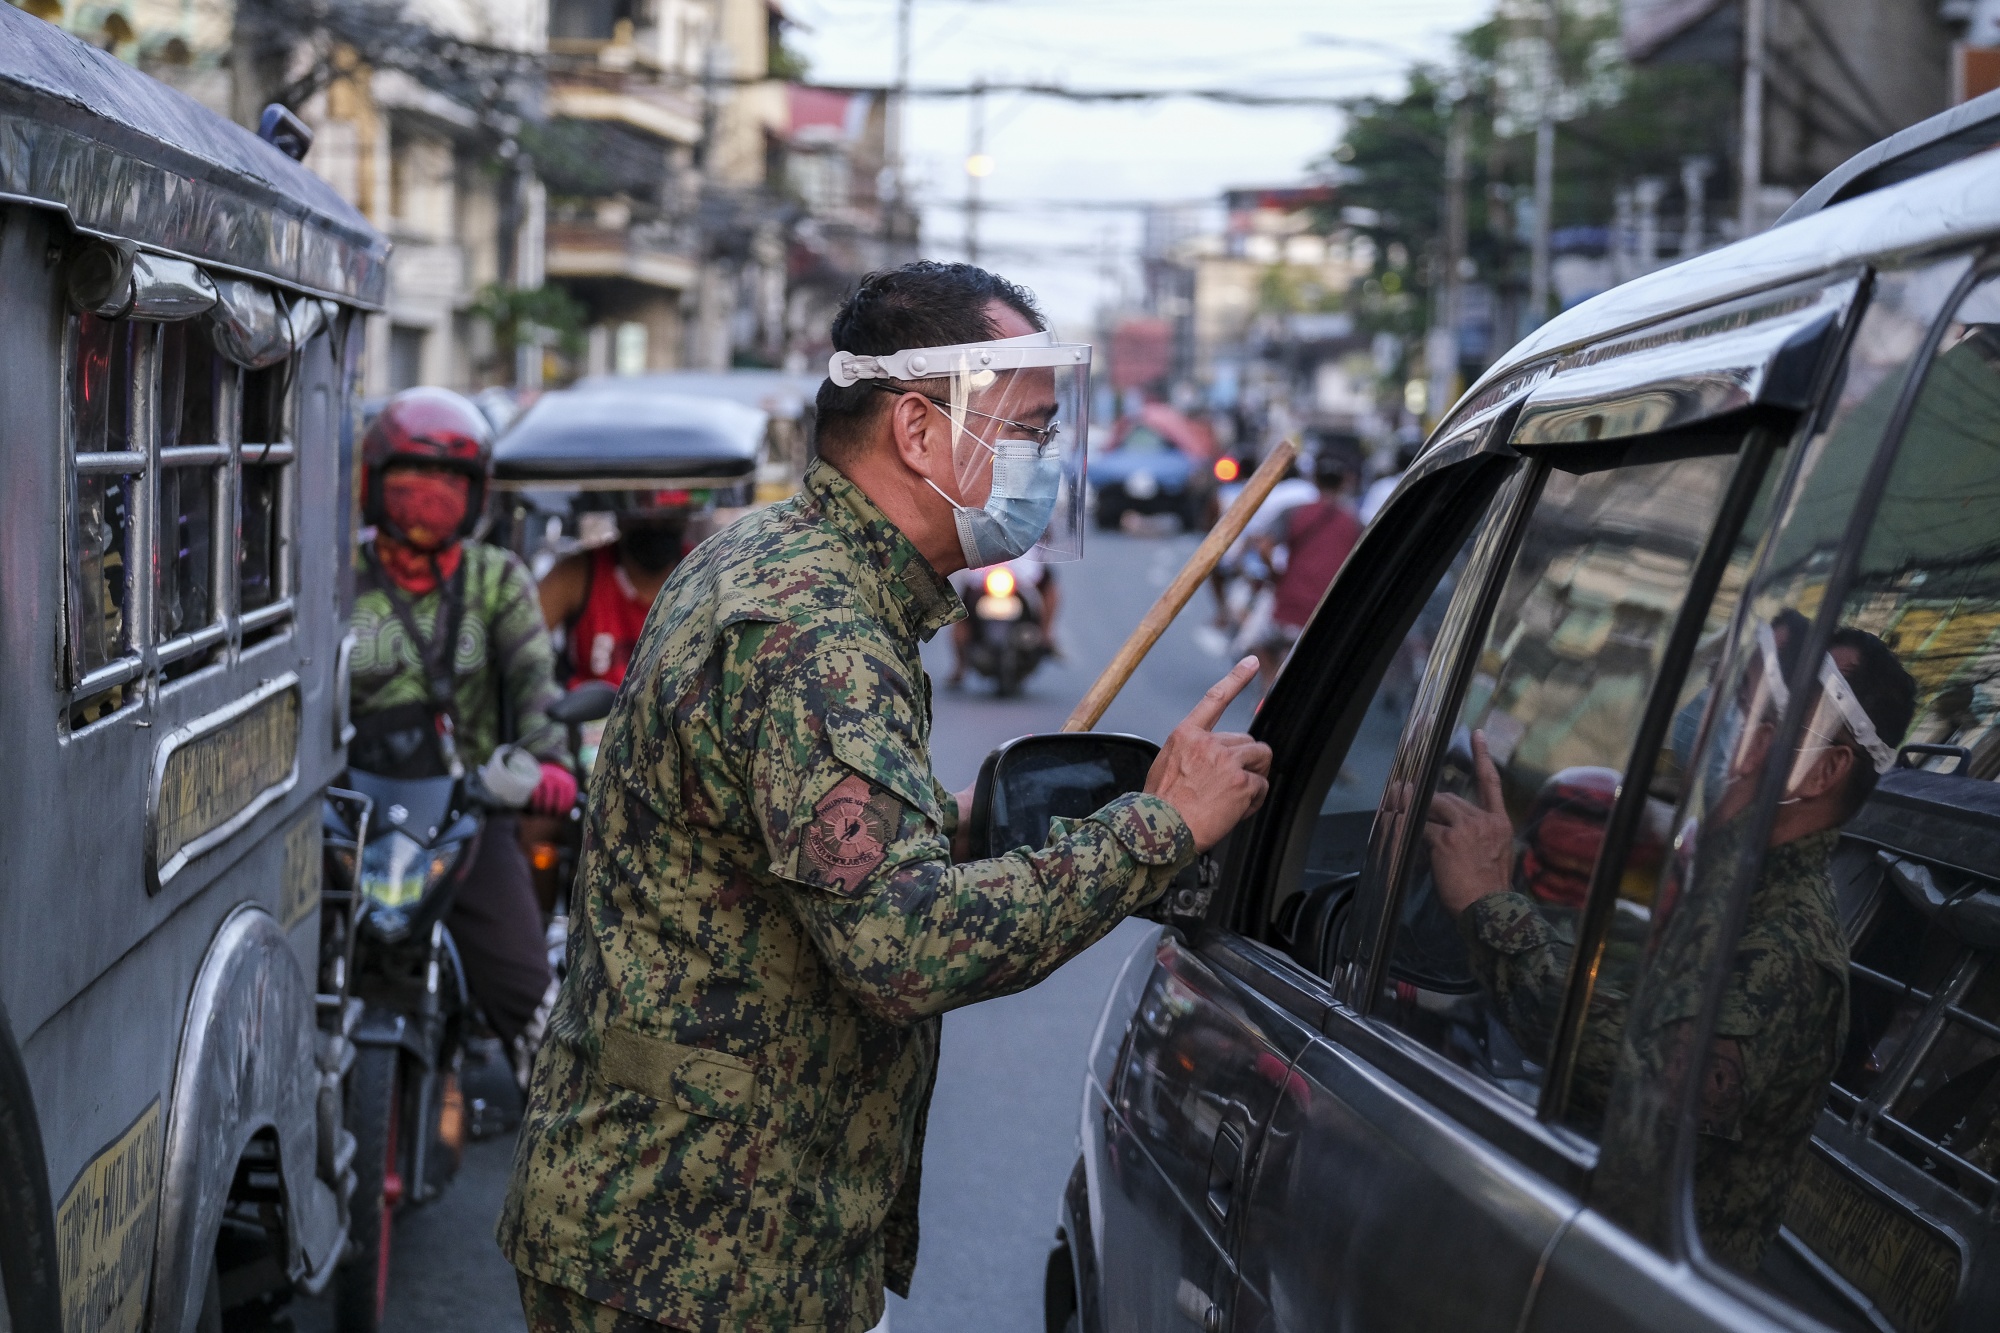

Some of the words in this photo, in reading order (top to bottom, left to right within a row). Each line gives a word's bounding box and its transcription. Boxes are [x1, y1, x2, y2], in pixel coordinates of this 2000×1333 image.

[818, 797, 854, 817] PHILIPPINE
[855, 799, 884, 819] NATIONAL
[101, 1134, 141, 1246] HOTLINE
